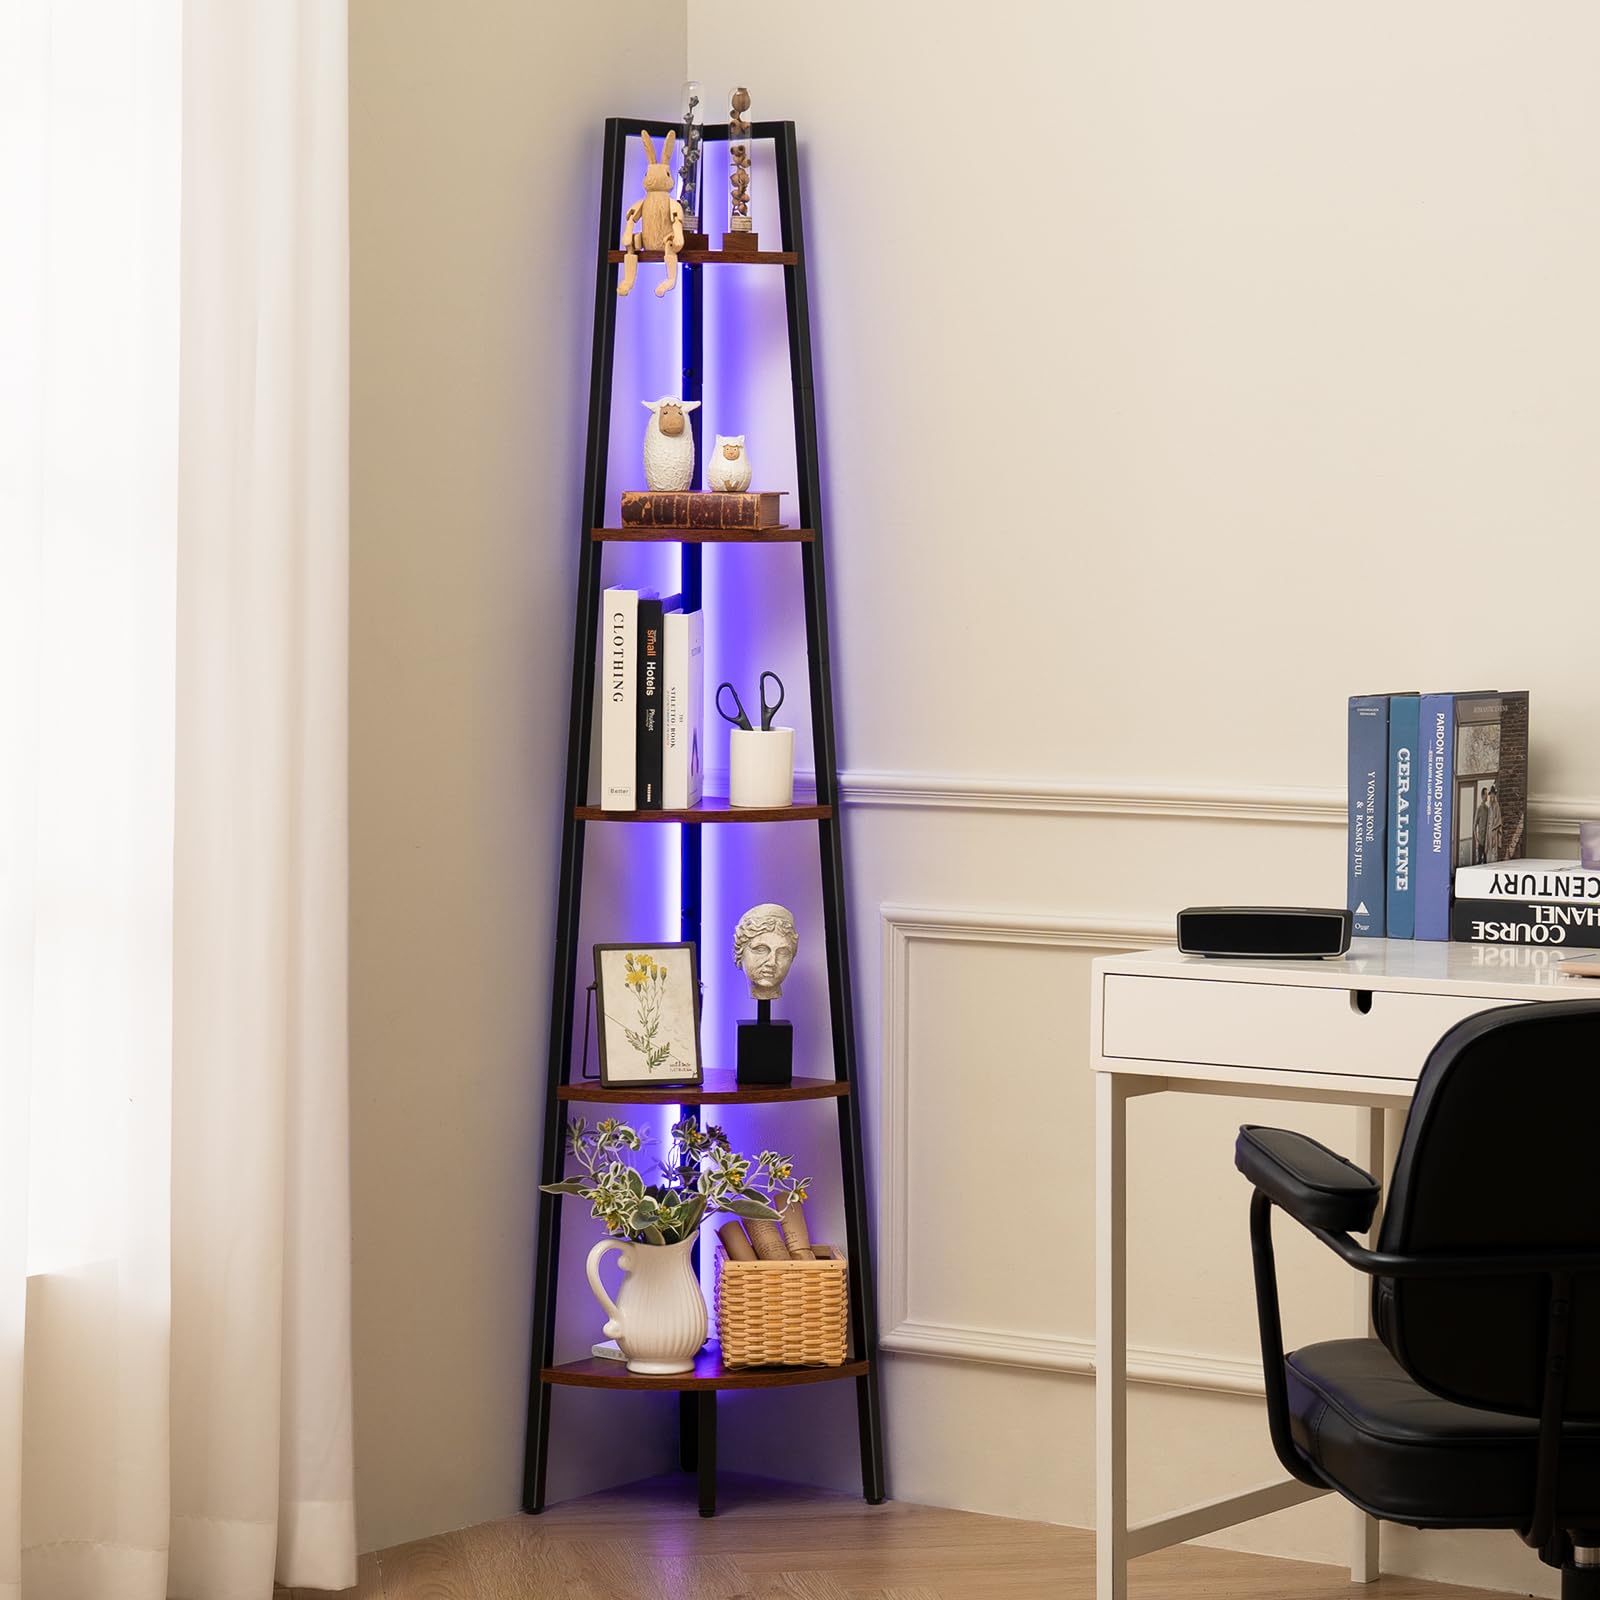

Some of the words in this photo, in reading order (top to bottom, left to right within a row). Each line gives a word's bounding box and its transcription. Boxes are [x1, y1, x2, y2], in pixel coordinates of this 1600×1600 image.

[613, 613, 624, 702] CLOTHING
[646, 629, 657, 657] small
[646, 661, 656, 696] Hotels
[648, 708, 656, 731] Phuket
[1436, 713, 1445, 755] PARDON
[1434, 757, 1444, 800] EDWARD
[1356, 801, 1364, 809] &
[1395, 747, 1411, 891] CERALDINE
[1354, 815, 1363, 853] RASMUS
[1365, 815, 1374, 842] KONÉ
[1432, 802, 1443, 853] SNOWDEN
[1354, 853, 1362, 877] JUUL
[1489, 874, 1600, 898] CENTURY
[1471, 921, 1566, 944] COURSE
